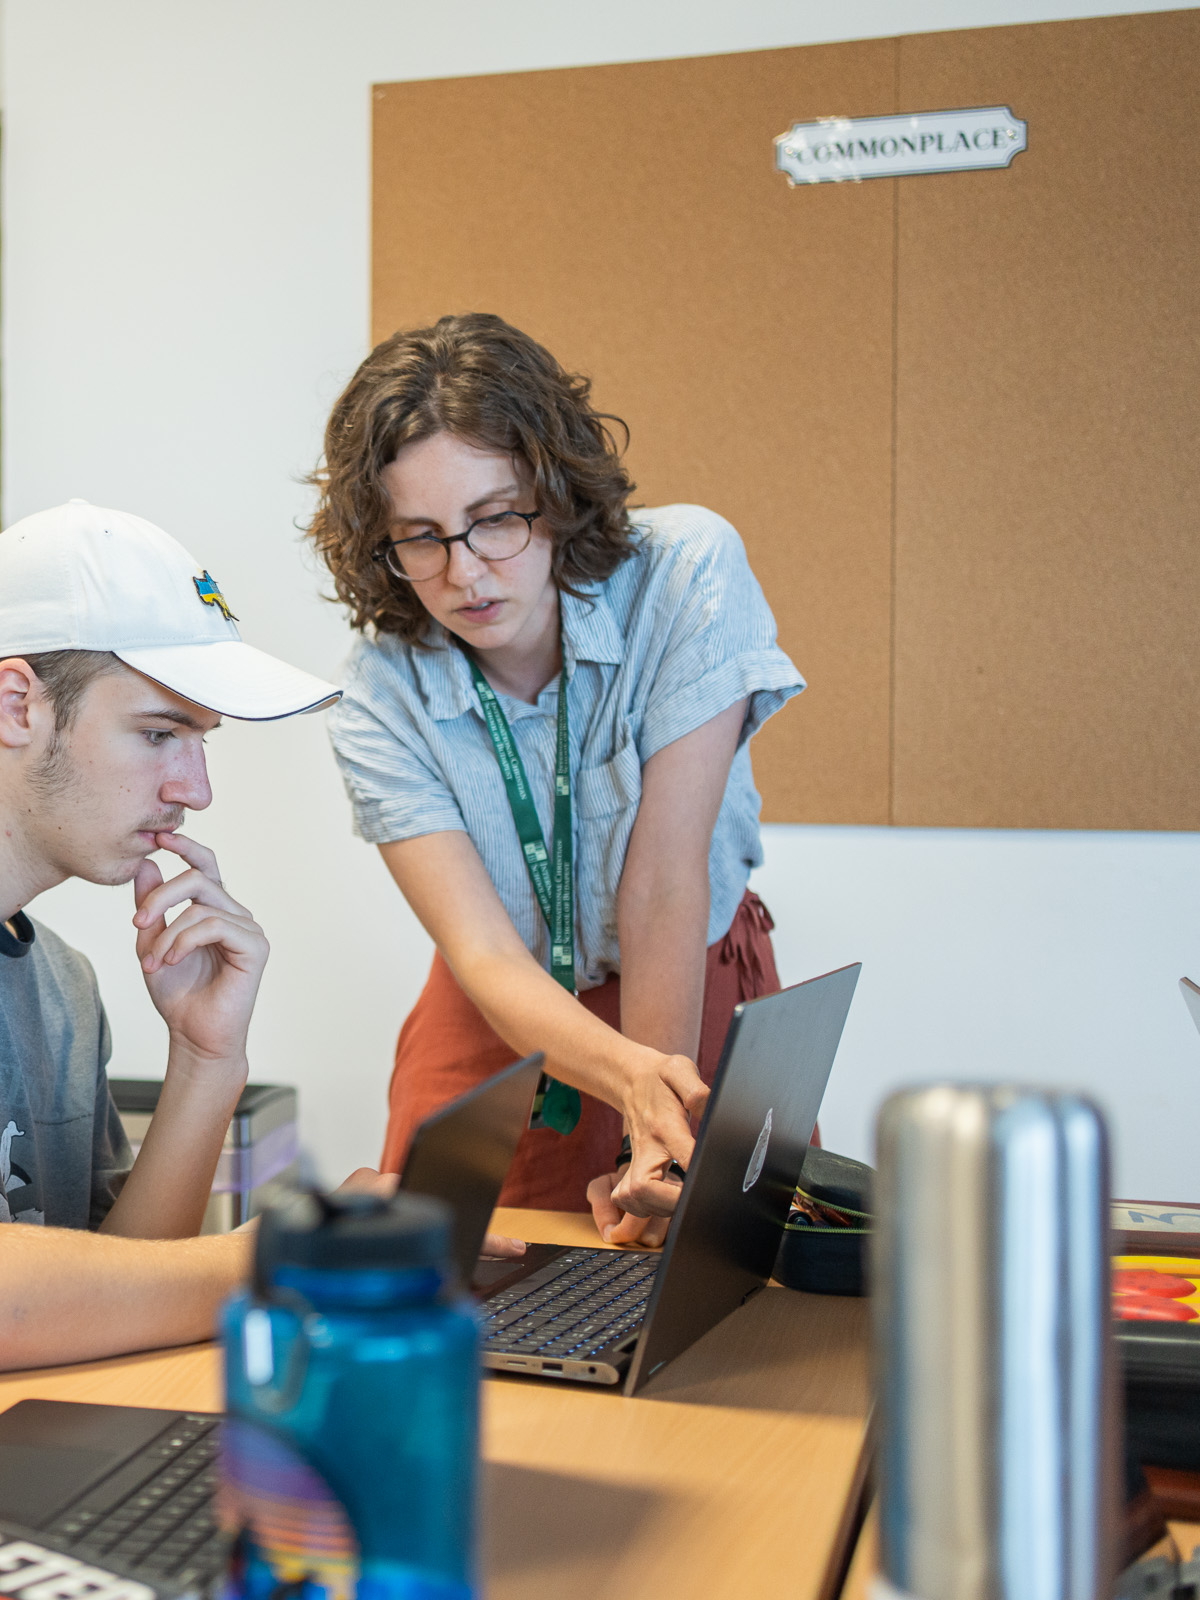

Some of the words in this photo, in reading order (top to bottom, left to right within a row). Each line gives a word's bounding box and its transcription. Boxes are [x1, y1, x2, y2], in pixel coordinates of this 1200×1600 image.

[796, 128, 1008, 165] COMMONPLACE
[490, 701, 514, 757] INTERNATIONAL
[511, 758, 528, 800] CHRISTIAN
[562, 862, 570, 900] BUDAPEST
[554, 883, 563, 944] INTERNATIONAL
